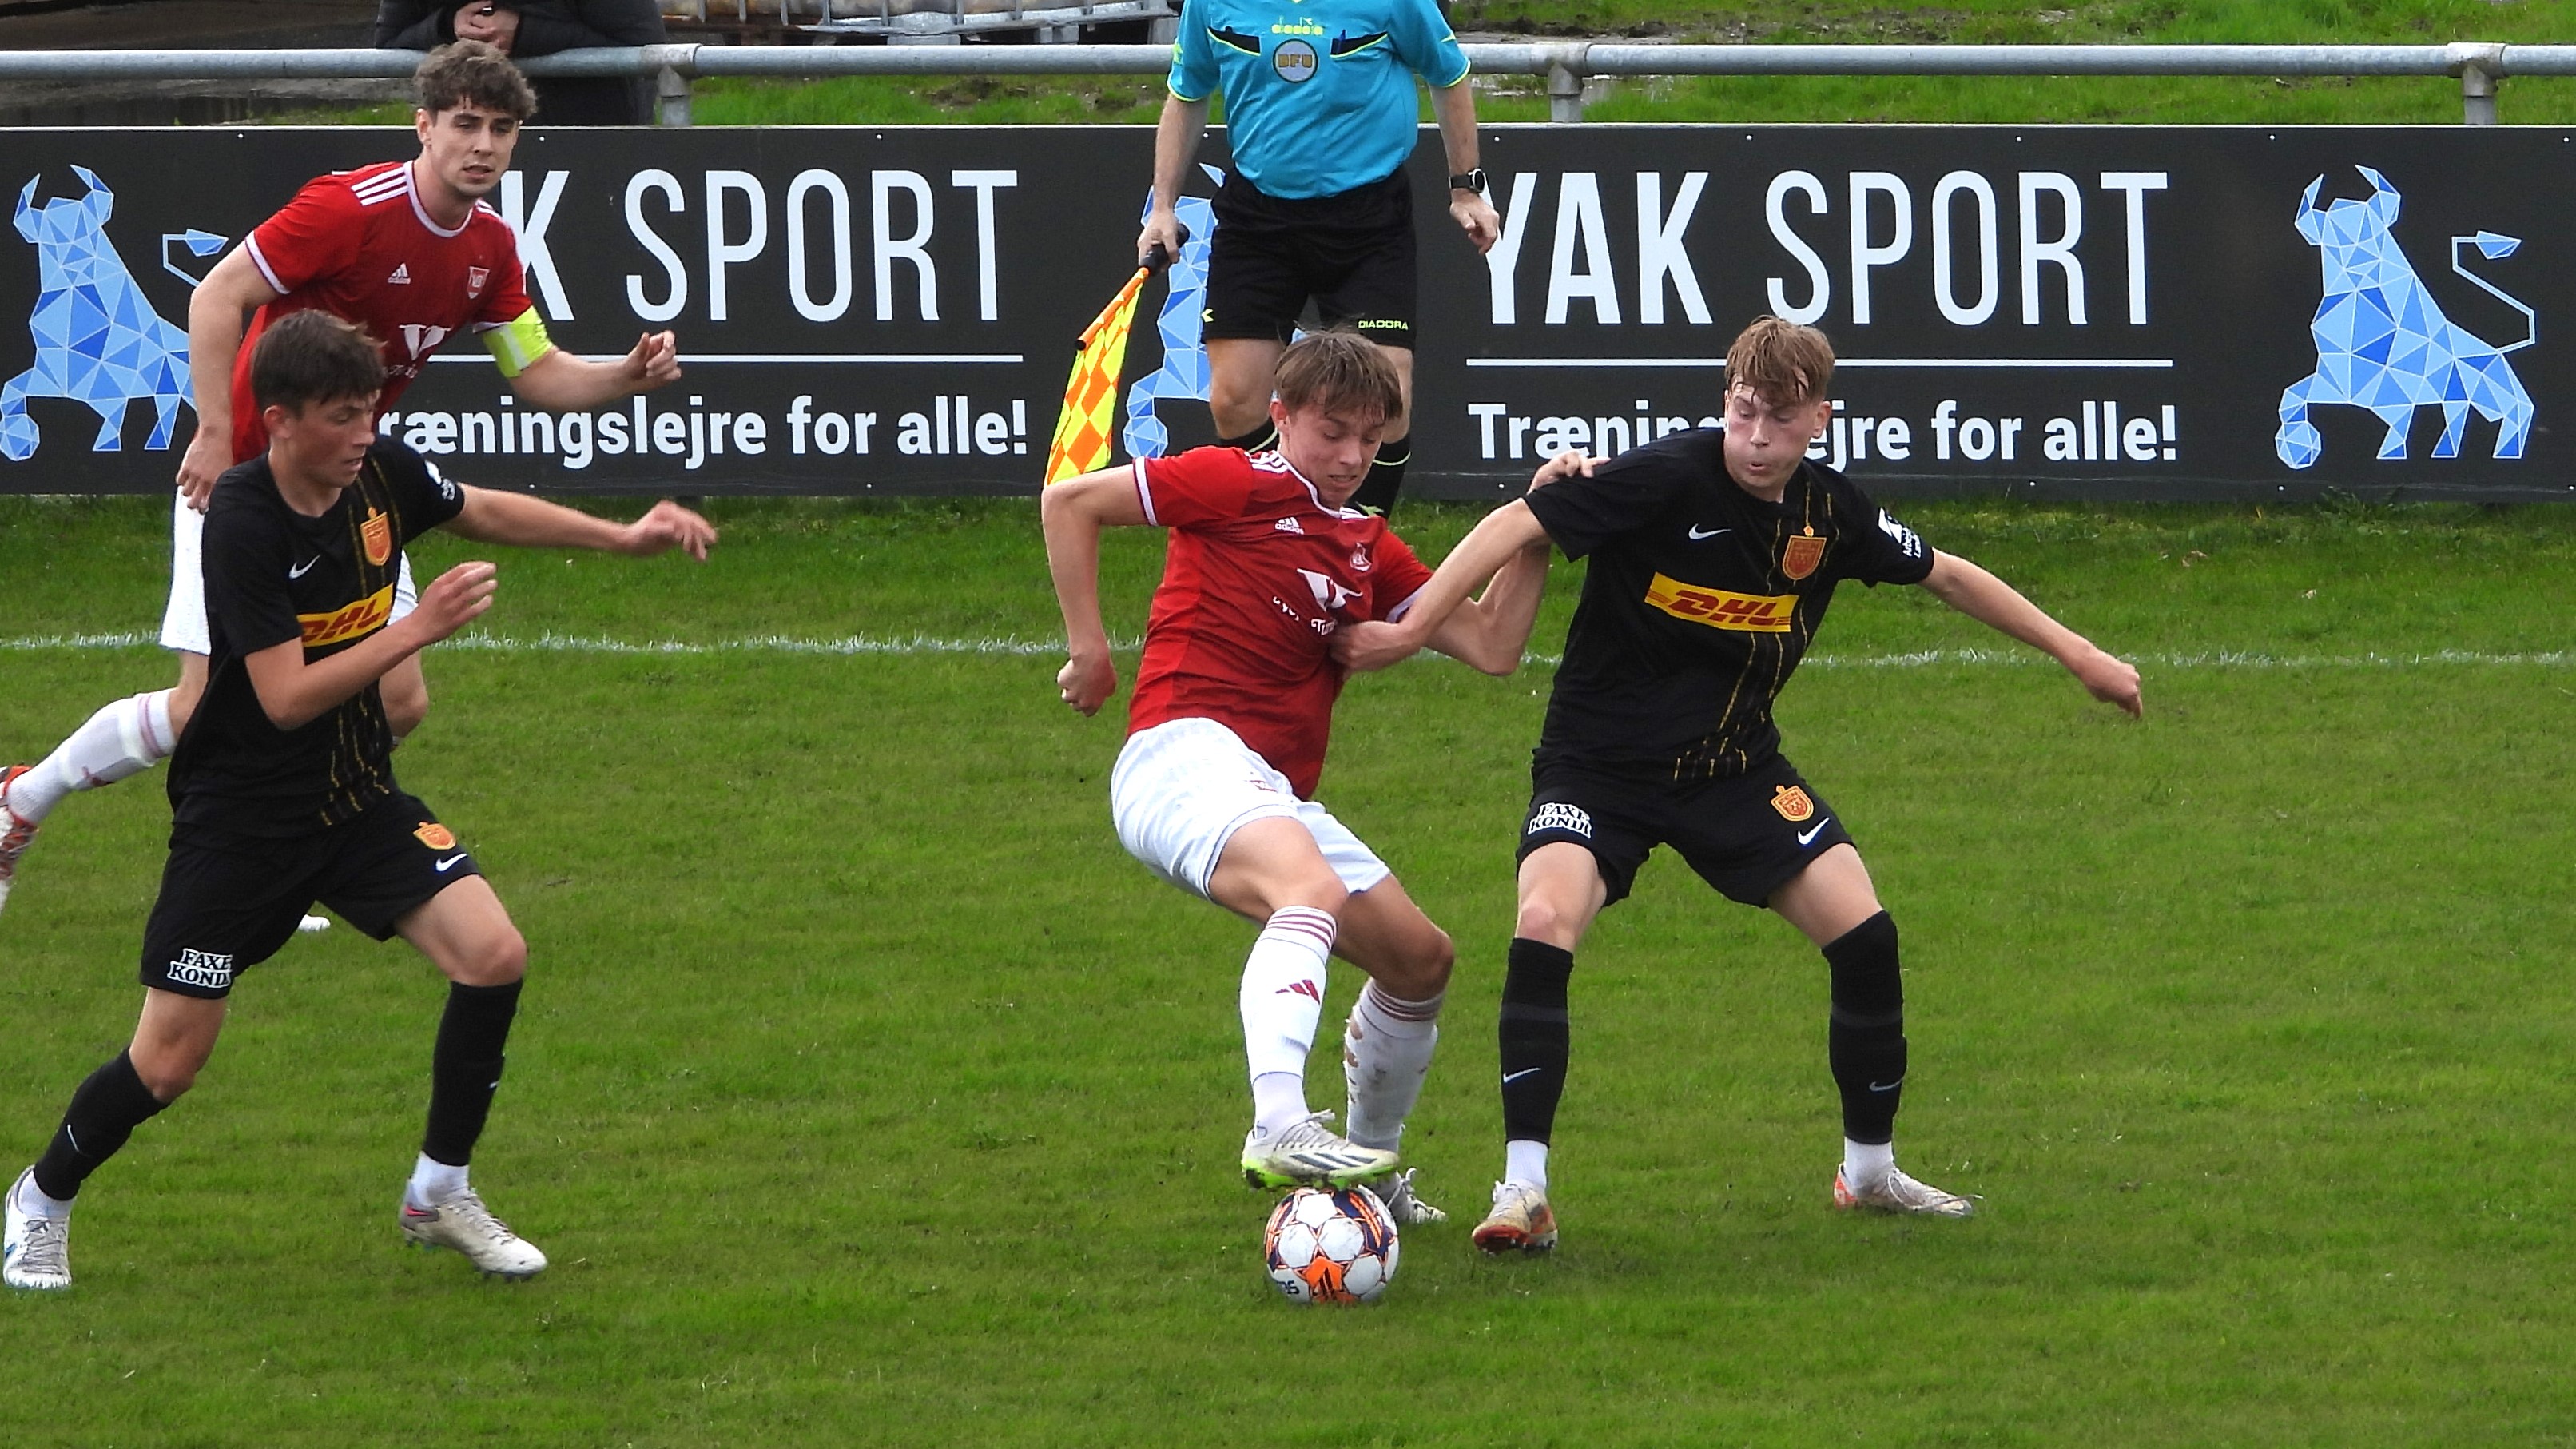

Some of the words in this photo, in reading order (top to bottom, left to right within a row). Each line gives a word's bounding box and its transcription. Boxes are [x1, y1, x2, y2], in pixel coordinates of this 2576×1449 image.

[624, 168, 1018, 323] SPORT
[1480, 171, 1713, 325] YAK
[1765, 169, 2168, 327] SPORT
[1358, 320, 1409, 332] DIADORA
[379, 395, 766, 470] ræningslejre
[786, 395, 877, 455] for
[896, 396, 1028, 456] alle!
[1468, 399, 1911, 473] Trænijre
[1930, 400, 2022, 460] for
[2043, 400, 2177, 461] alle!
[300, 599, 381, 643] DHL
[1668, 590, 1778, 627] DHL
[1528, 815, 1592, 838] KONDI
[1540, 802, 1590, 822] FAXE
[181, 948, 233, 970] FAXE
